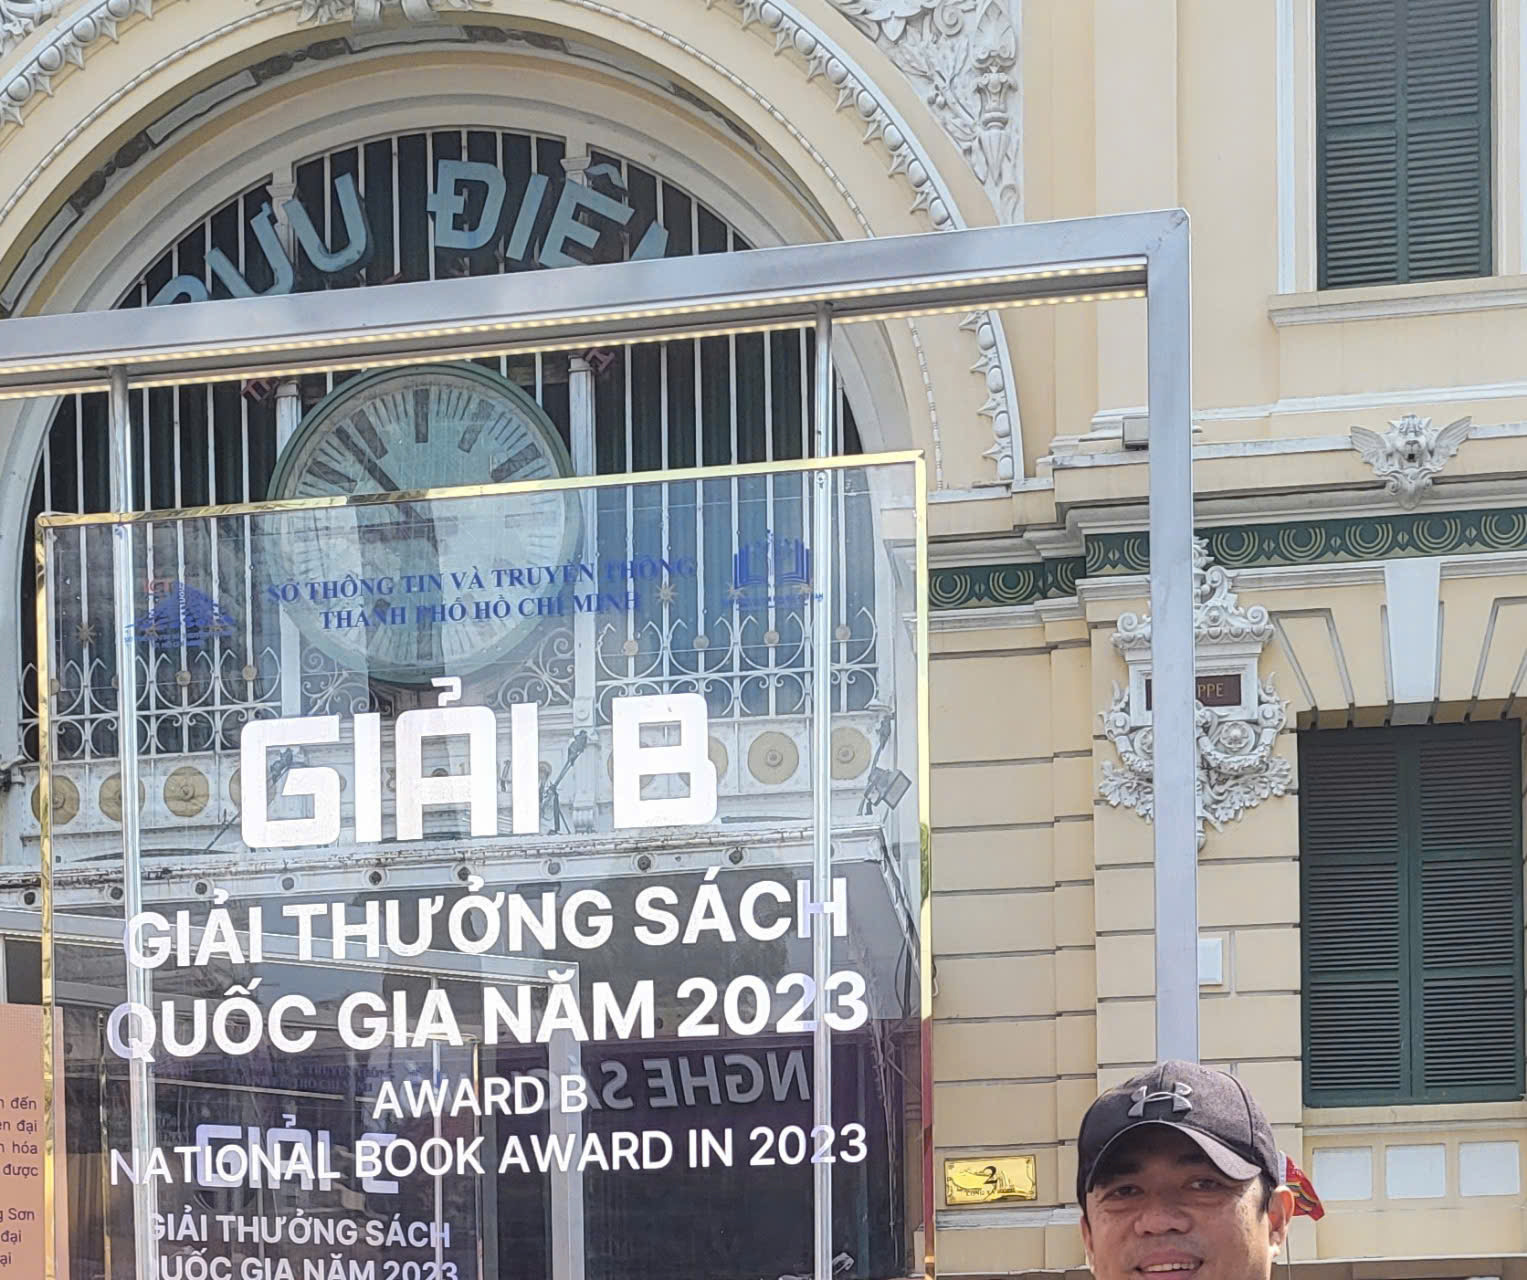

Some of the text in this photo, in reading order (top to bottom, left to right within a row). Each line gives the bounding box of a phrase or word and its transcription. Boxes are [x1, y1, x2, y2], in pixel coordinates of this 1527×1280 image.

[305, 575, 394, 600] THÔNG
[401, 574, 443, 595] TIN
[451, 564, 486, 592] VÀ
[491, 560, 598, 588] TRUYỀN
[319, 602, 407, 630] THÀNH
[472, 594, 512, 621] HỒ
[572, 590, 641, 614] MINH
[1198, 682, 1224, 698] PPE
[241, 676, 719, 848] GIẢI B
[124, 867, 848, 970] GIẢI THƯỞNG SÁCH
[106, 970, 869, 1062] QUỐC GIA NĂM 2023
[11, 1096, 37, 1110] đến
[371, 1075, 545, 1119] AWARD
[560, 1074, 588, 1113] B
[17, 1120, 37, 1135] đại
[12, 1141, 38, 1154] hóa
[110, 1123, 867, 1185] NATIONAL BOOK AWARD IN 2023
[3, 1164, 39, 1179] được
[984, 1166, 997, 1184] 2
[8, 1208, 35, 1220] Sơn
[151, 1205, 450, 1248] GIẢI THƯỞNG SÁCH
[1, 1230, 22, 1245] đại
